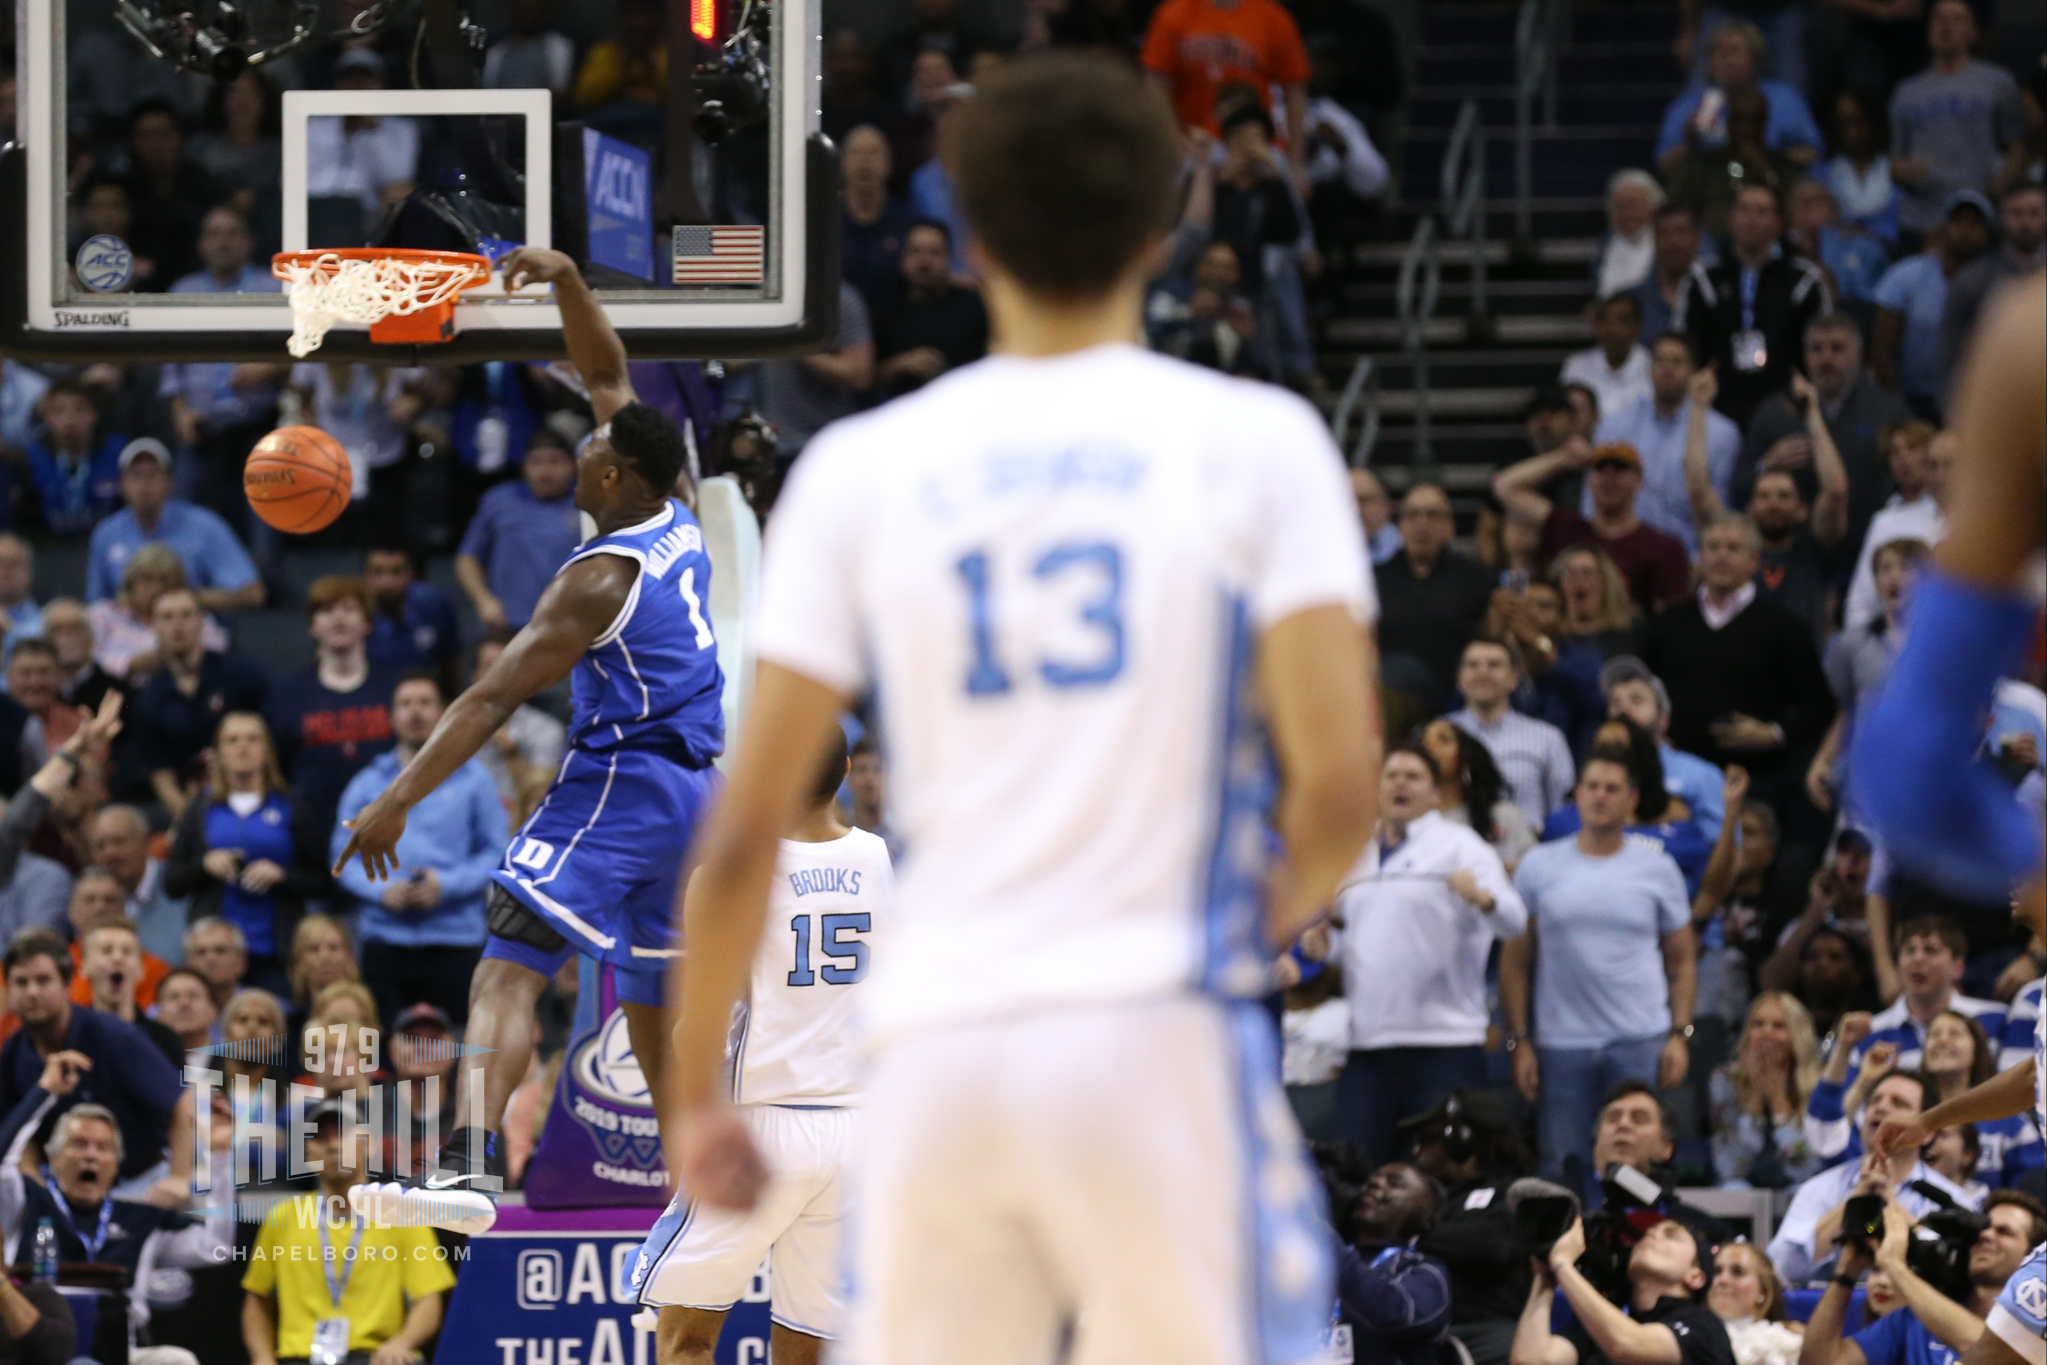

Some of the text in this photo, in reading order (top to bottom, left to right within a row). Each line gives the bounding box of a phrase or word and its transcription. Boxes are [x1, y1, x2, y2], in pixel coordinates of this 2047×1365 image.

[85, 250, 131, 268] ACC
[54, 310, 130, 327] SPALDING
[678, 566, 715, 651] 1
[955, 541, 1126, 697] 13
[511, 836, 555, 870] D
[788, 867, 862, 898] BROOKS
[786, 911, 871, 987] 15
[574, 1095, 660, 1138] 2019 TOU
[592, 1160, 671, 1188] CHARLOT
